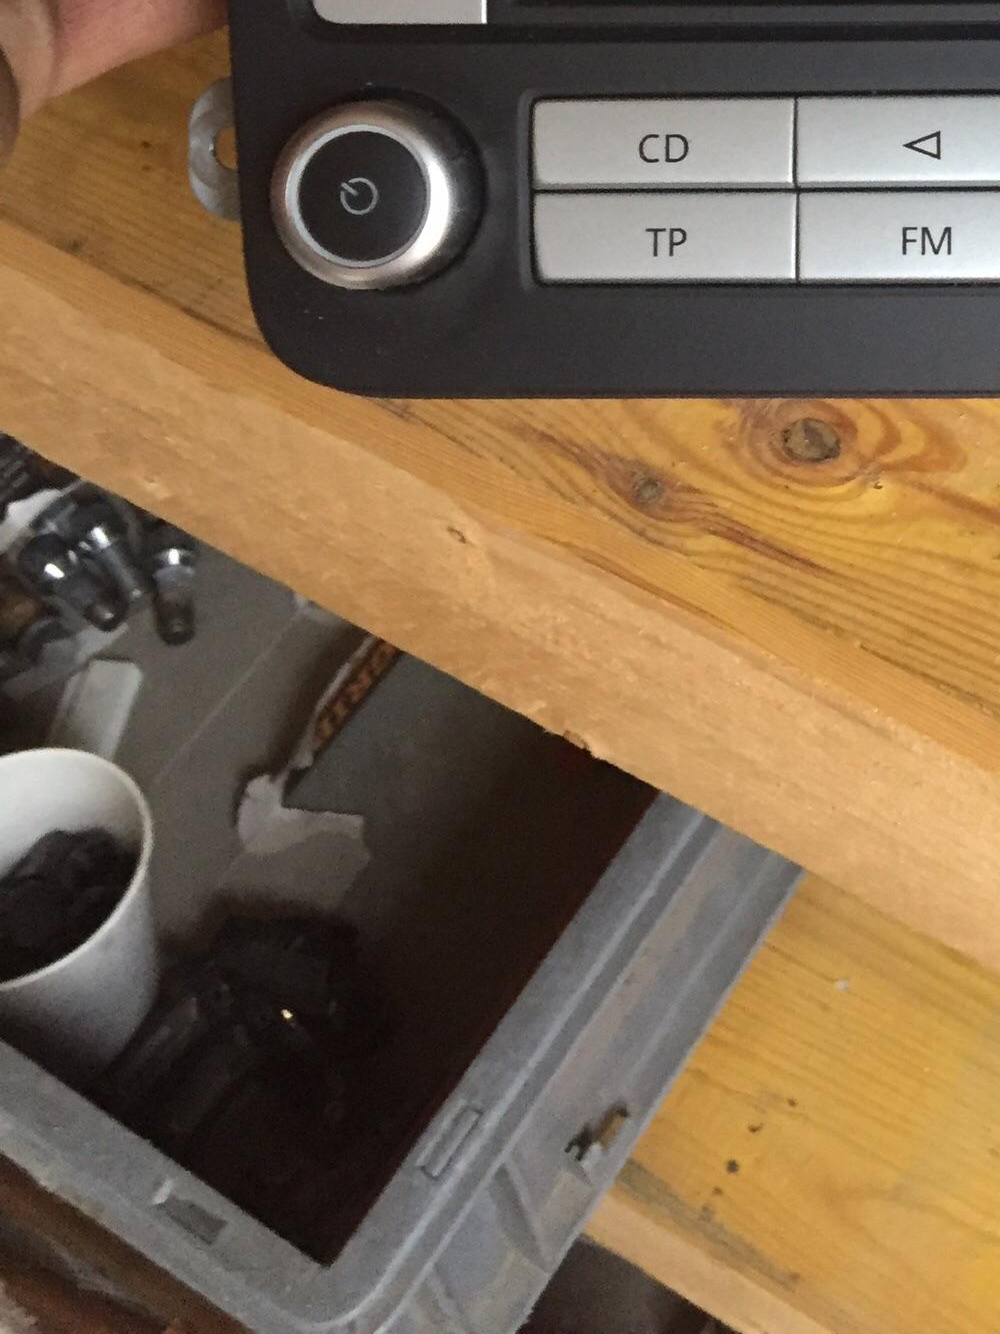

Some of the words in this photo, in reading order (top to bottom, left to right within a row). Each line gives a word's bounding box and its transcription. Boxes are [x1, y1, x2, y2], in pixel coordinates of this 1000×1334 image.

[637, 133, 690, 164] CD
[646, 227, 688, 258] TP
[900, 226, 953, 256] FM
